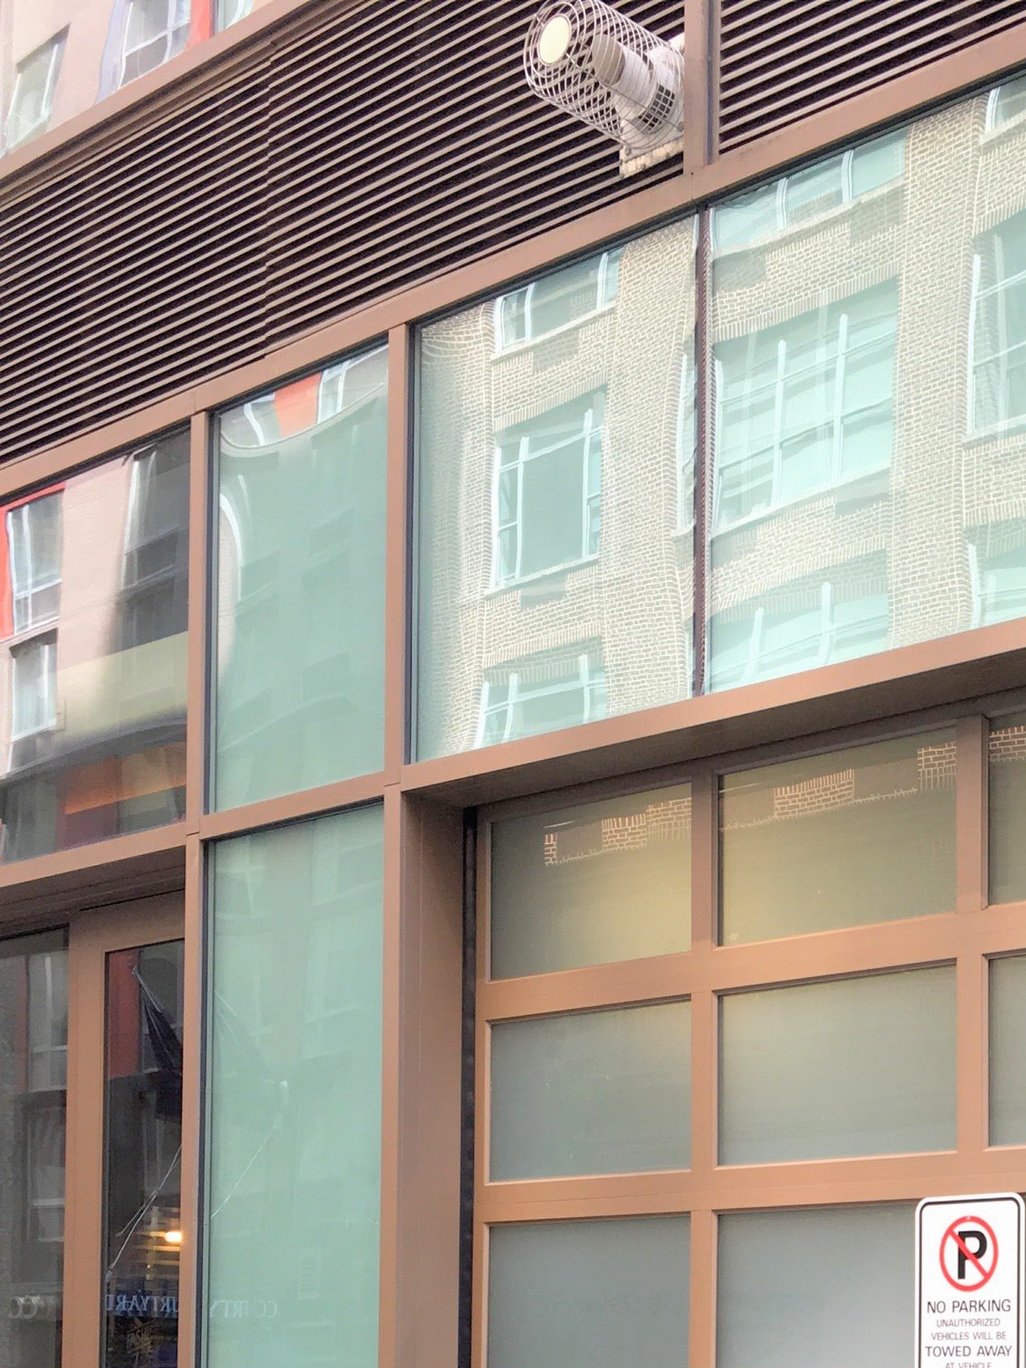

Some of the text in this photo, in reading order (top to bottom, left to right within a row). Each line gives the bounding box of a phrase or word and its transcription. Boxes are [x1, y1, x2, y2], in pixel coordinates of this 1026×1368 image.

[927, 1299, 1011, 1313] NO PARKING
[936, 1318, 1001, 1328] UNAUTHORIZED
[930, 1331, 1007, 1341] VEHICLES WILL BE
[925, 1345, 1012, 1358] TOWED AWAY
